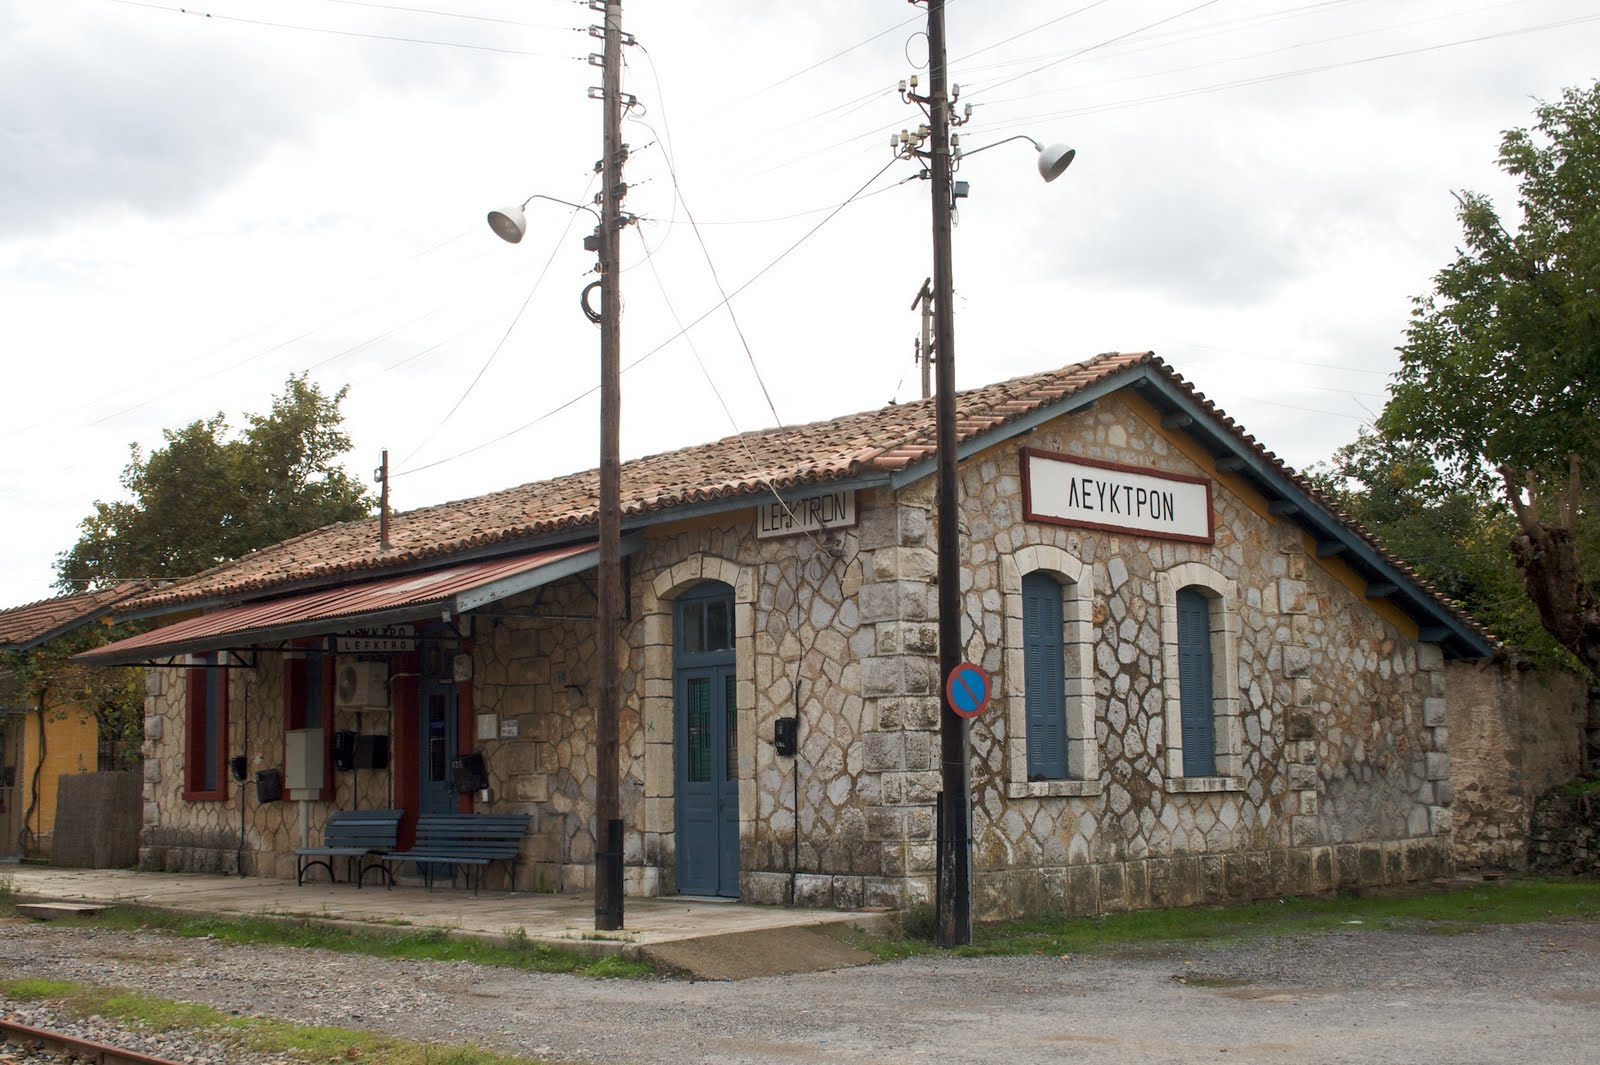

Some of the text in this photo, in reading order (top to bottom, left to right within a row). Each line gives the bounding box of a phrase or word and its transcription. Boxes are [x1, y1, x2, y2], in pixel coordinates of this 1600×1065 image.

[762, 491, 846, 532] LEFKTRON
[1068, 477, 1174, 522] ΛΕΥΚΤΡΟΝ
[345, 640, 406, 650] LEFKTRO
